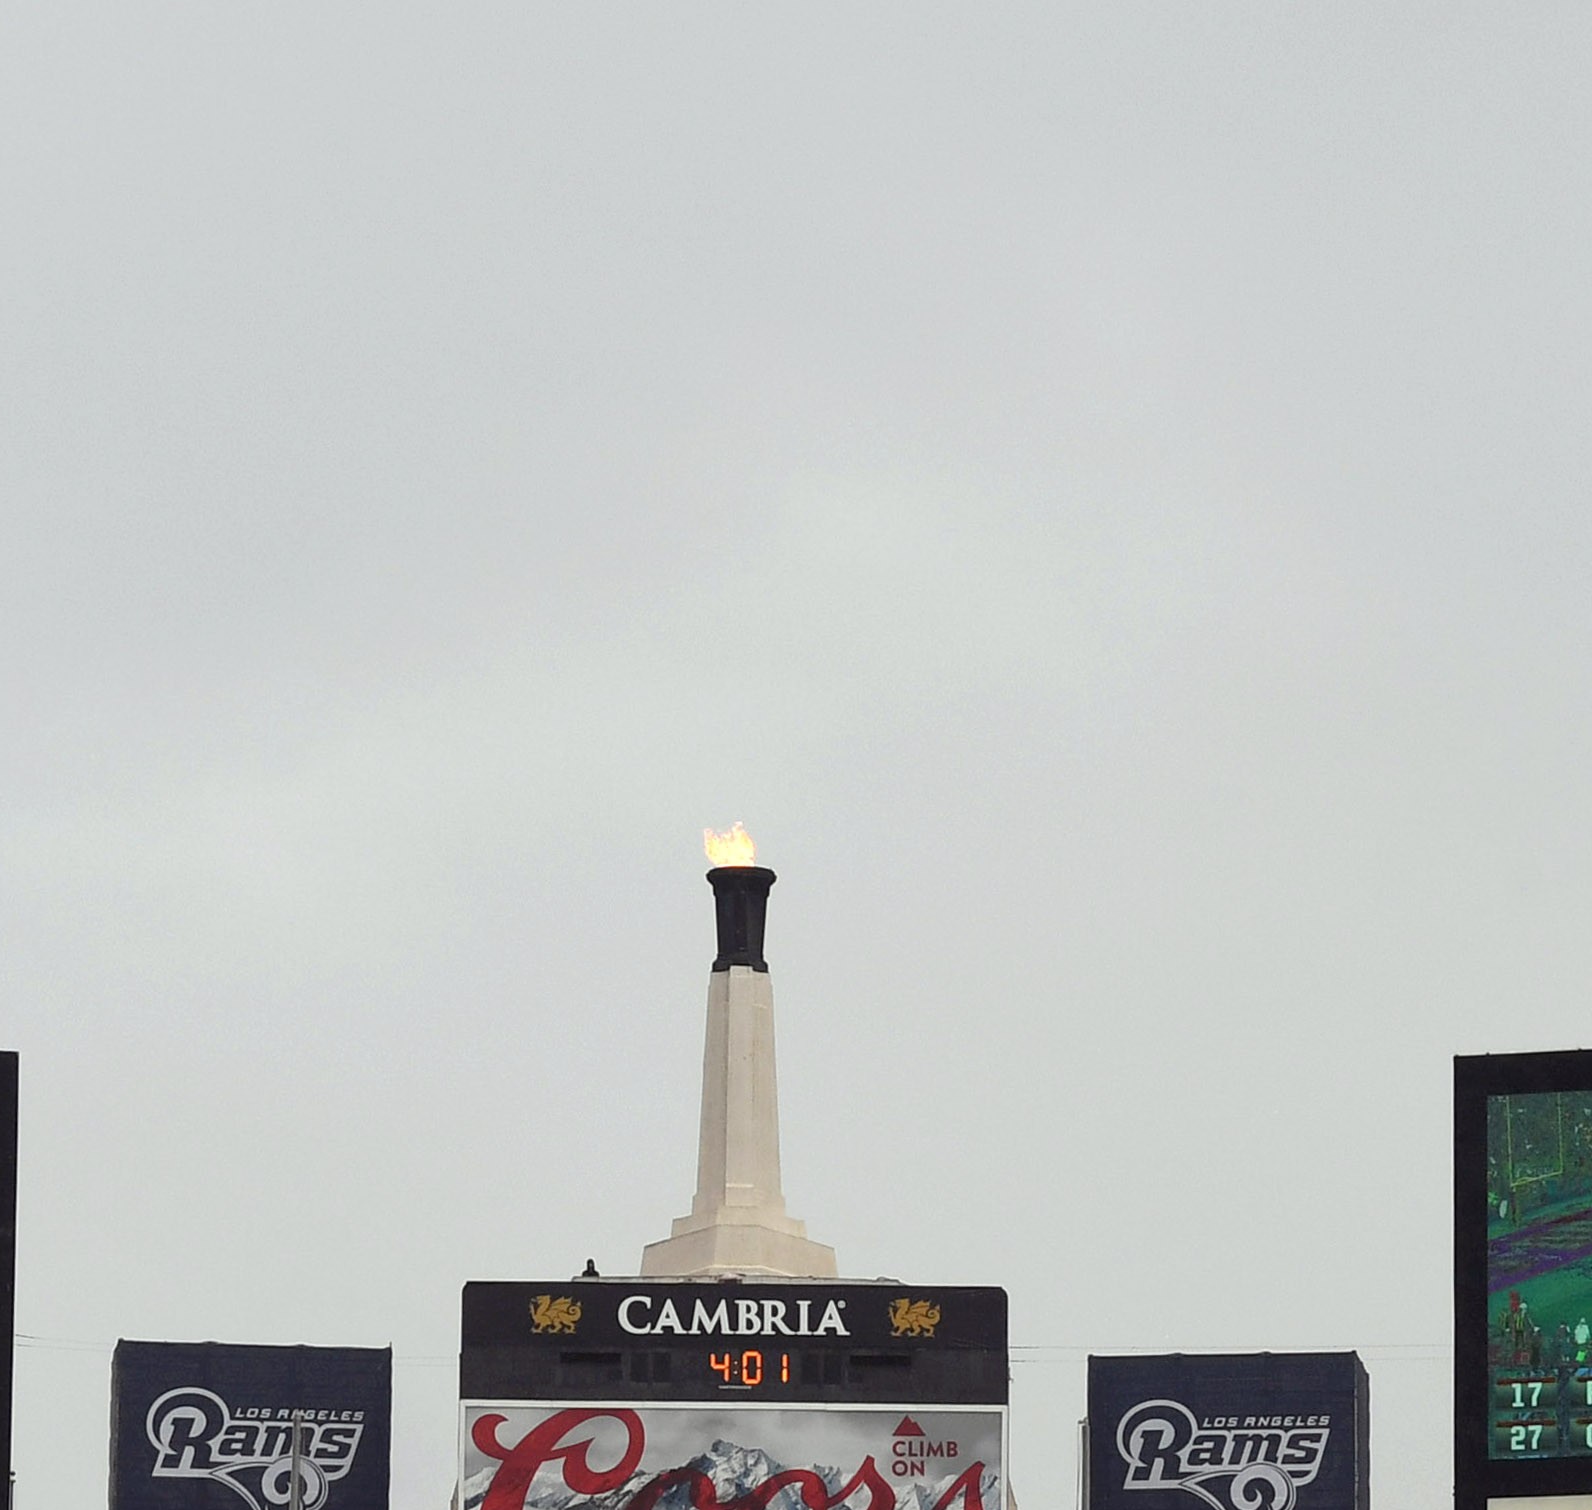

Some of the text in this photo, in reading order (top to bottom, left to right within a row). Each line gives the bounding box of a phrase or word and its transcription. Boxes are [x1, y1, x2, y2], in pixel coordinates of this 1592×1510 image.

[617, 1297, 850, 1337] CAMBRIA
[709, 1350, 790, 1386] 4:01
[1510, 1382, 1542, 1408] 17
[235, 1408, 272, 1419] LOS
[1203, 1416, 1330, 1428] LOS ANGELES
[892, 1440, 959, 1459] CLIMB
[1116, 1399, 1330, 1490] Rams
[1510, 1425, 1542, 1451] 27
[892, 1460, 925, 1477] ON
